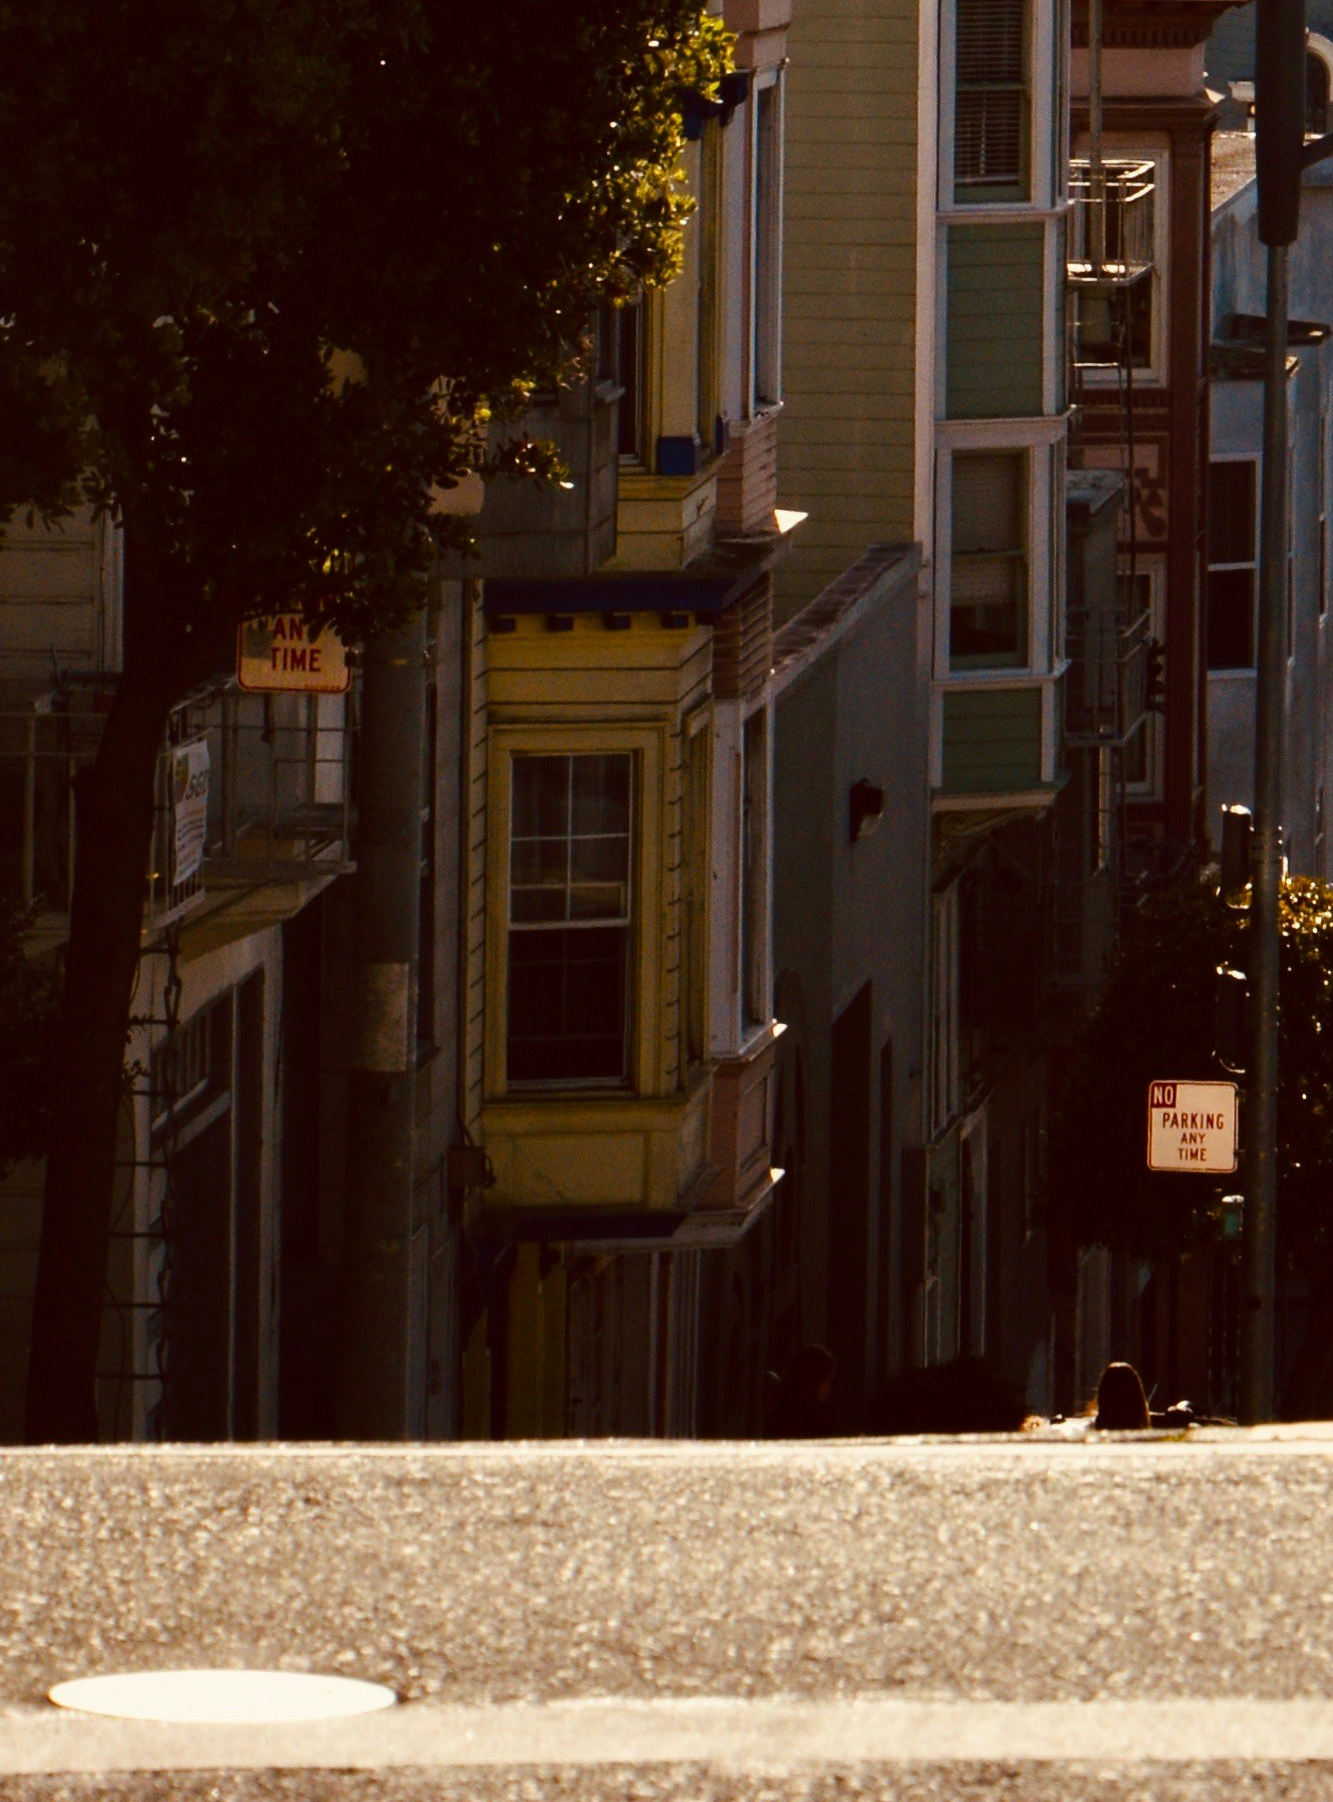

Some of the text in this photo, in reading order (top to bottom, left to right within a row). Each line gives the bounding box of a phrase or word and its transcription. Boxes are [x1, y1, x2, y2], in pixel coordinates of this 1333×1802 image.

[273, 617, 304, 641] AN
[271, 647, 322, 672] TIME
[1153, 1085, 1174, 1105] NO
[1162, 1112, 1224, 1129] PARKING
[1181, 1133, 1206, 1144] ANY
[1178, 1148, 1206, 1161] TIME
